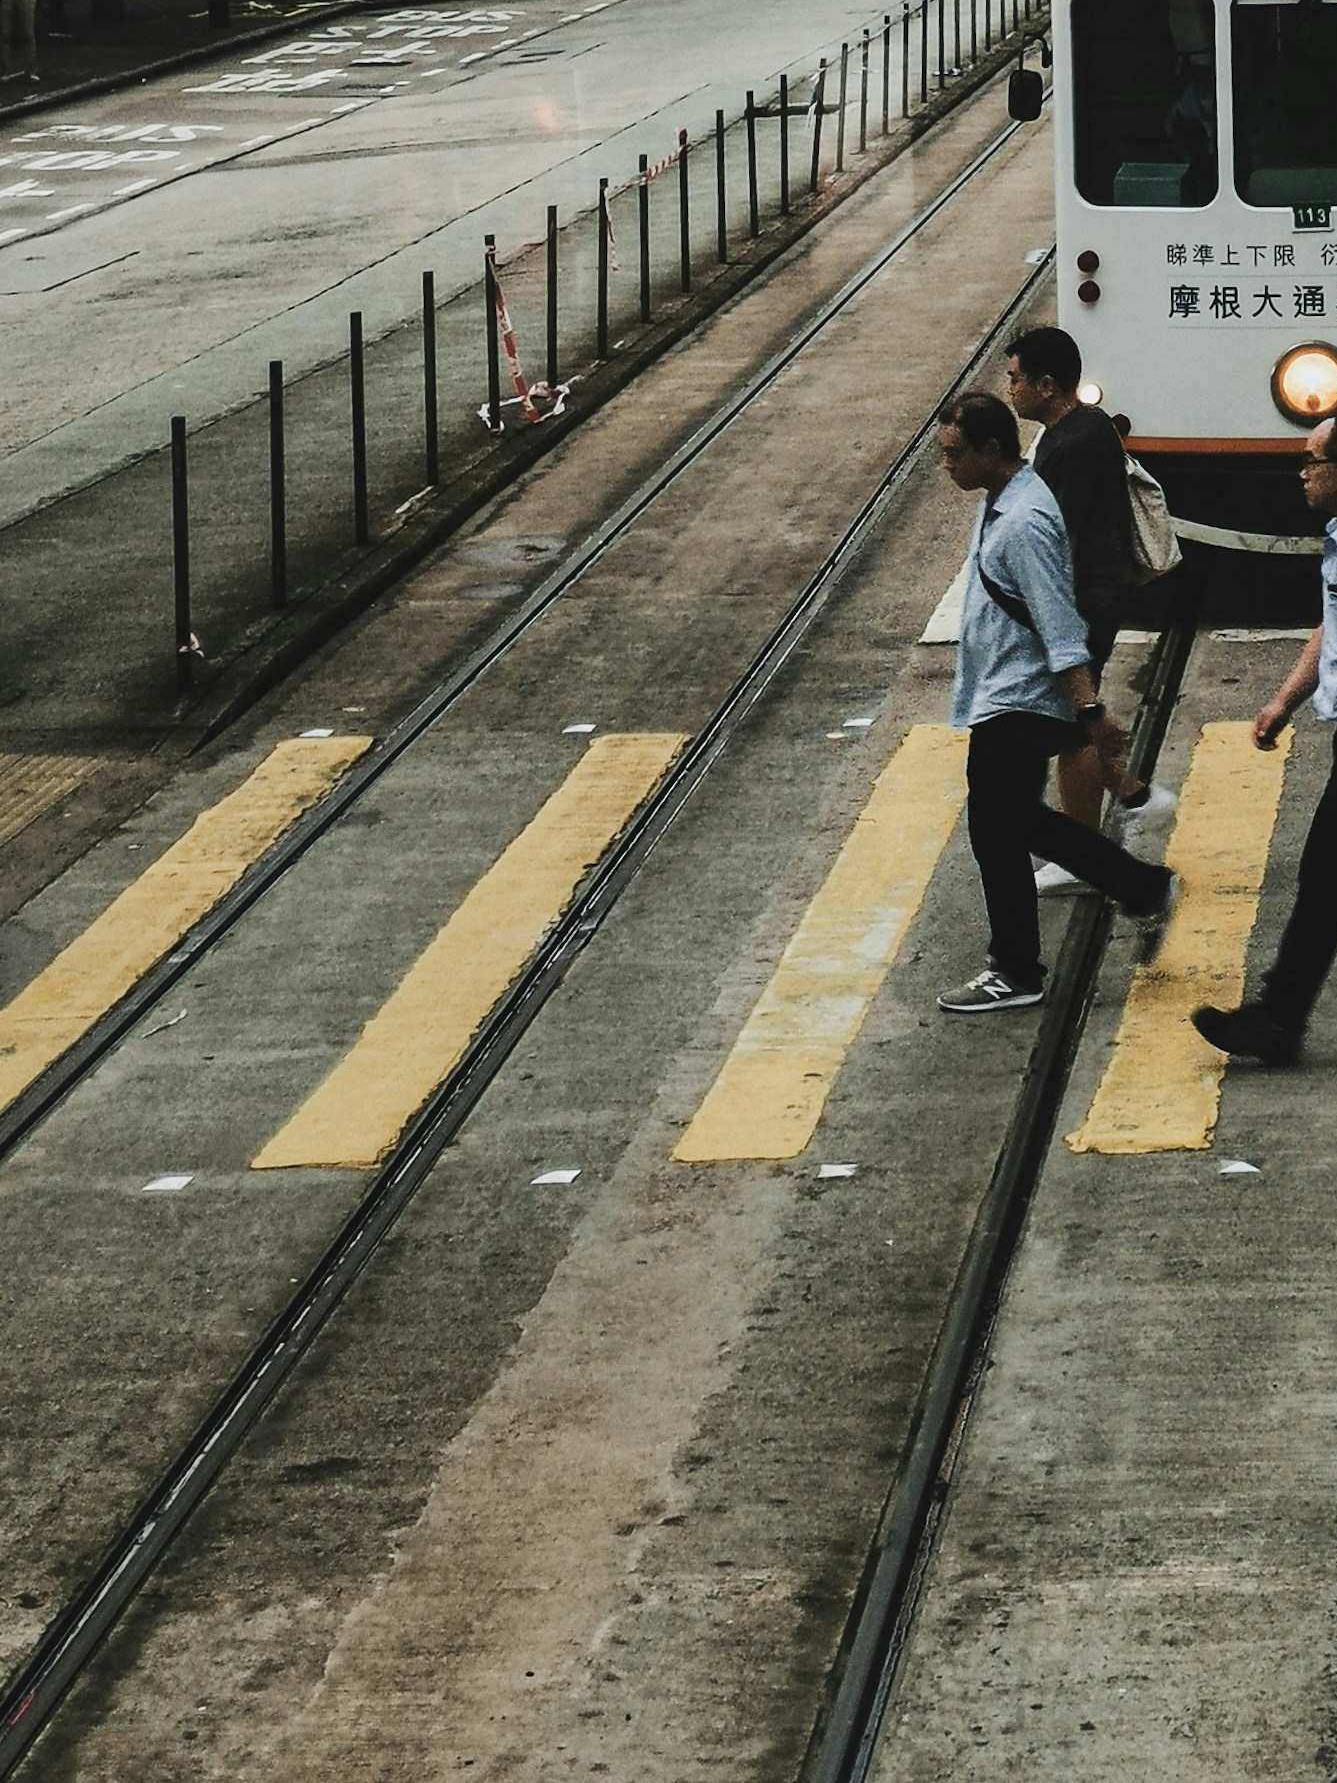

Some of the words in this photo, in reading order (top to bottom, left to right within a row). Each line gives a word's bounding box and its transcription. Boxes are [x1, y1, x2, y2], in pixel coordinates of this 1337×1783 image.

[375, 10, 526, 22] BUS
[309, 25, 510, 39] STOP
[242, 40, 437, 65] 巴士
[11, 123, 225, 143] BUS
[0, 149, 181, 171] TOP
[1297, 207, 1327, 224] 113
[1166, 244, 1296, 267] 睇準上下限
